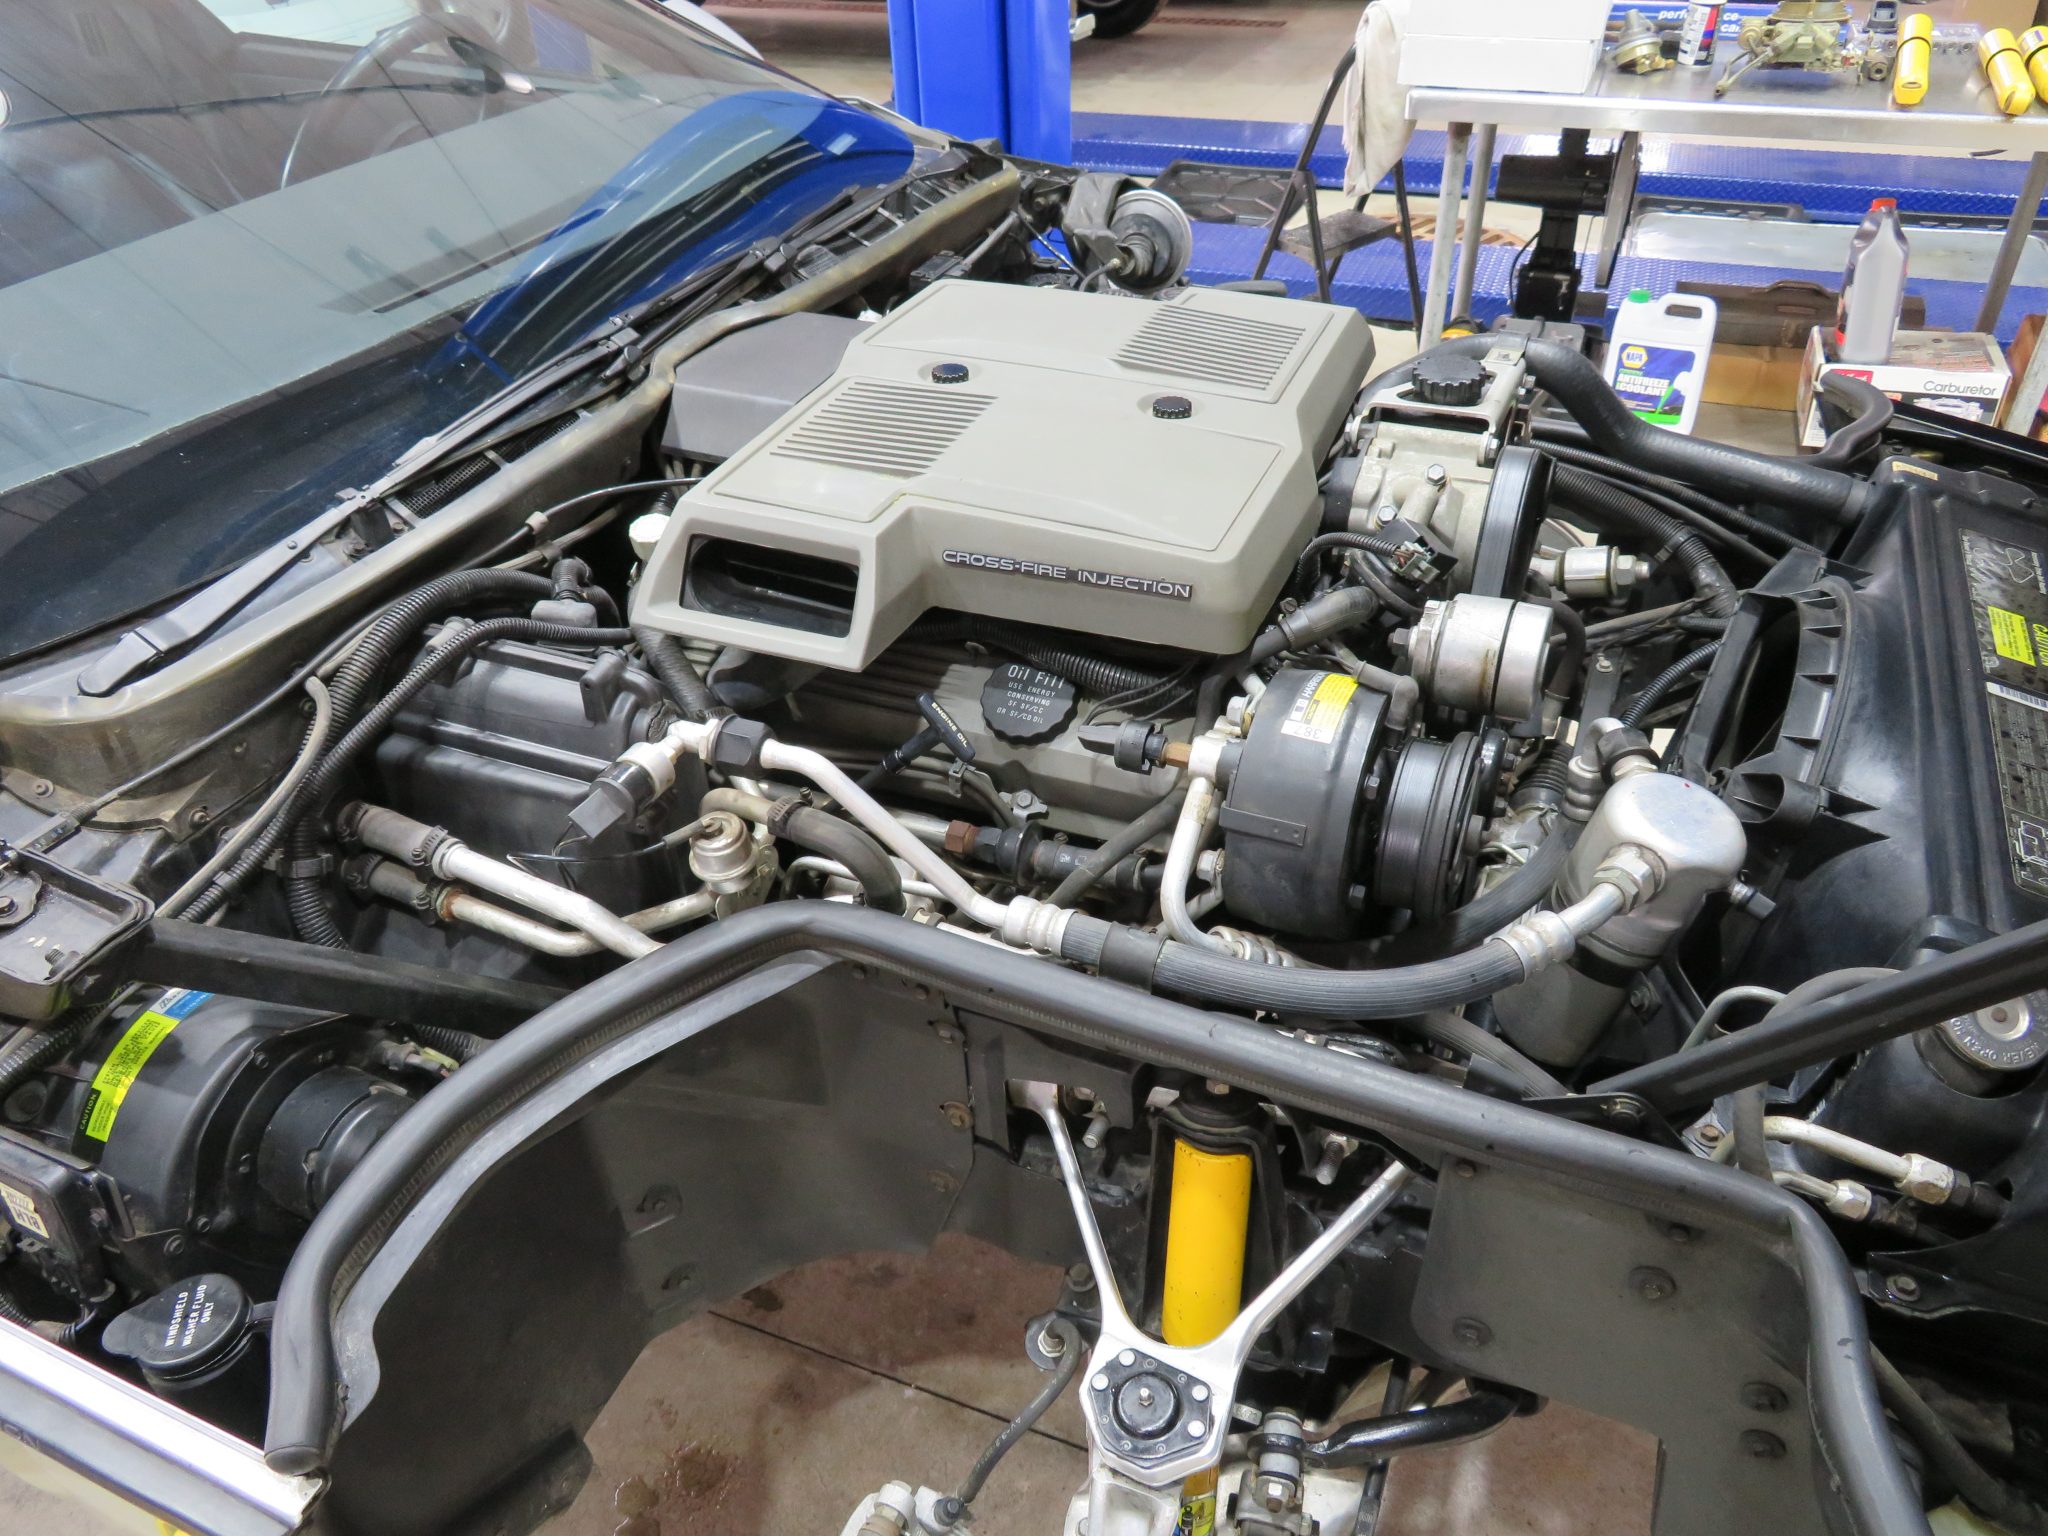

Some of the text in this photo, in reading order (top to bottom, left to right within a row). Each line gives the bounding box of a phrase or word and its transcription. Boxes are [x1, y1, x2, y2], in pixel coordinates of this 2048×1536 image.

[1617, 373, 1670, 388] ANTIFREEZE
[1922, 380, 1997, 396] Carburetor
[942, 550, 1190, 598] CROSS-FIRE INJECTION
[1008, 665, 1065, 688] Oil Fill
[1007, 690, 1051, 707] CONSERVING
[1008, 681, 1056, 698] USE ENERGY
[1010, 710, 1032, 720] SF/CD
[1033, 716, 1043, 724] OIL
[1020, 702, 1044, 714] SF/CC
[931, 701, 968, 748] ENGINE OIL
[79, 1093, 97, 1130] CAUTION
[164, 1291, 189, 1348] WINDSHIELD
[182, 1284, 208, 1347] WASHER FLUID
[200, 1302, 214, 1325] ONLY
